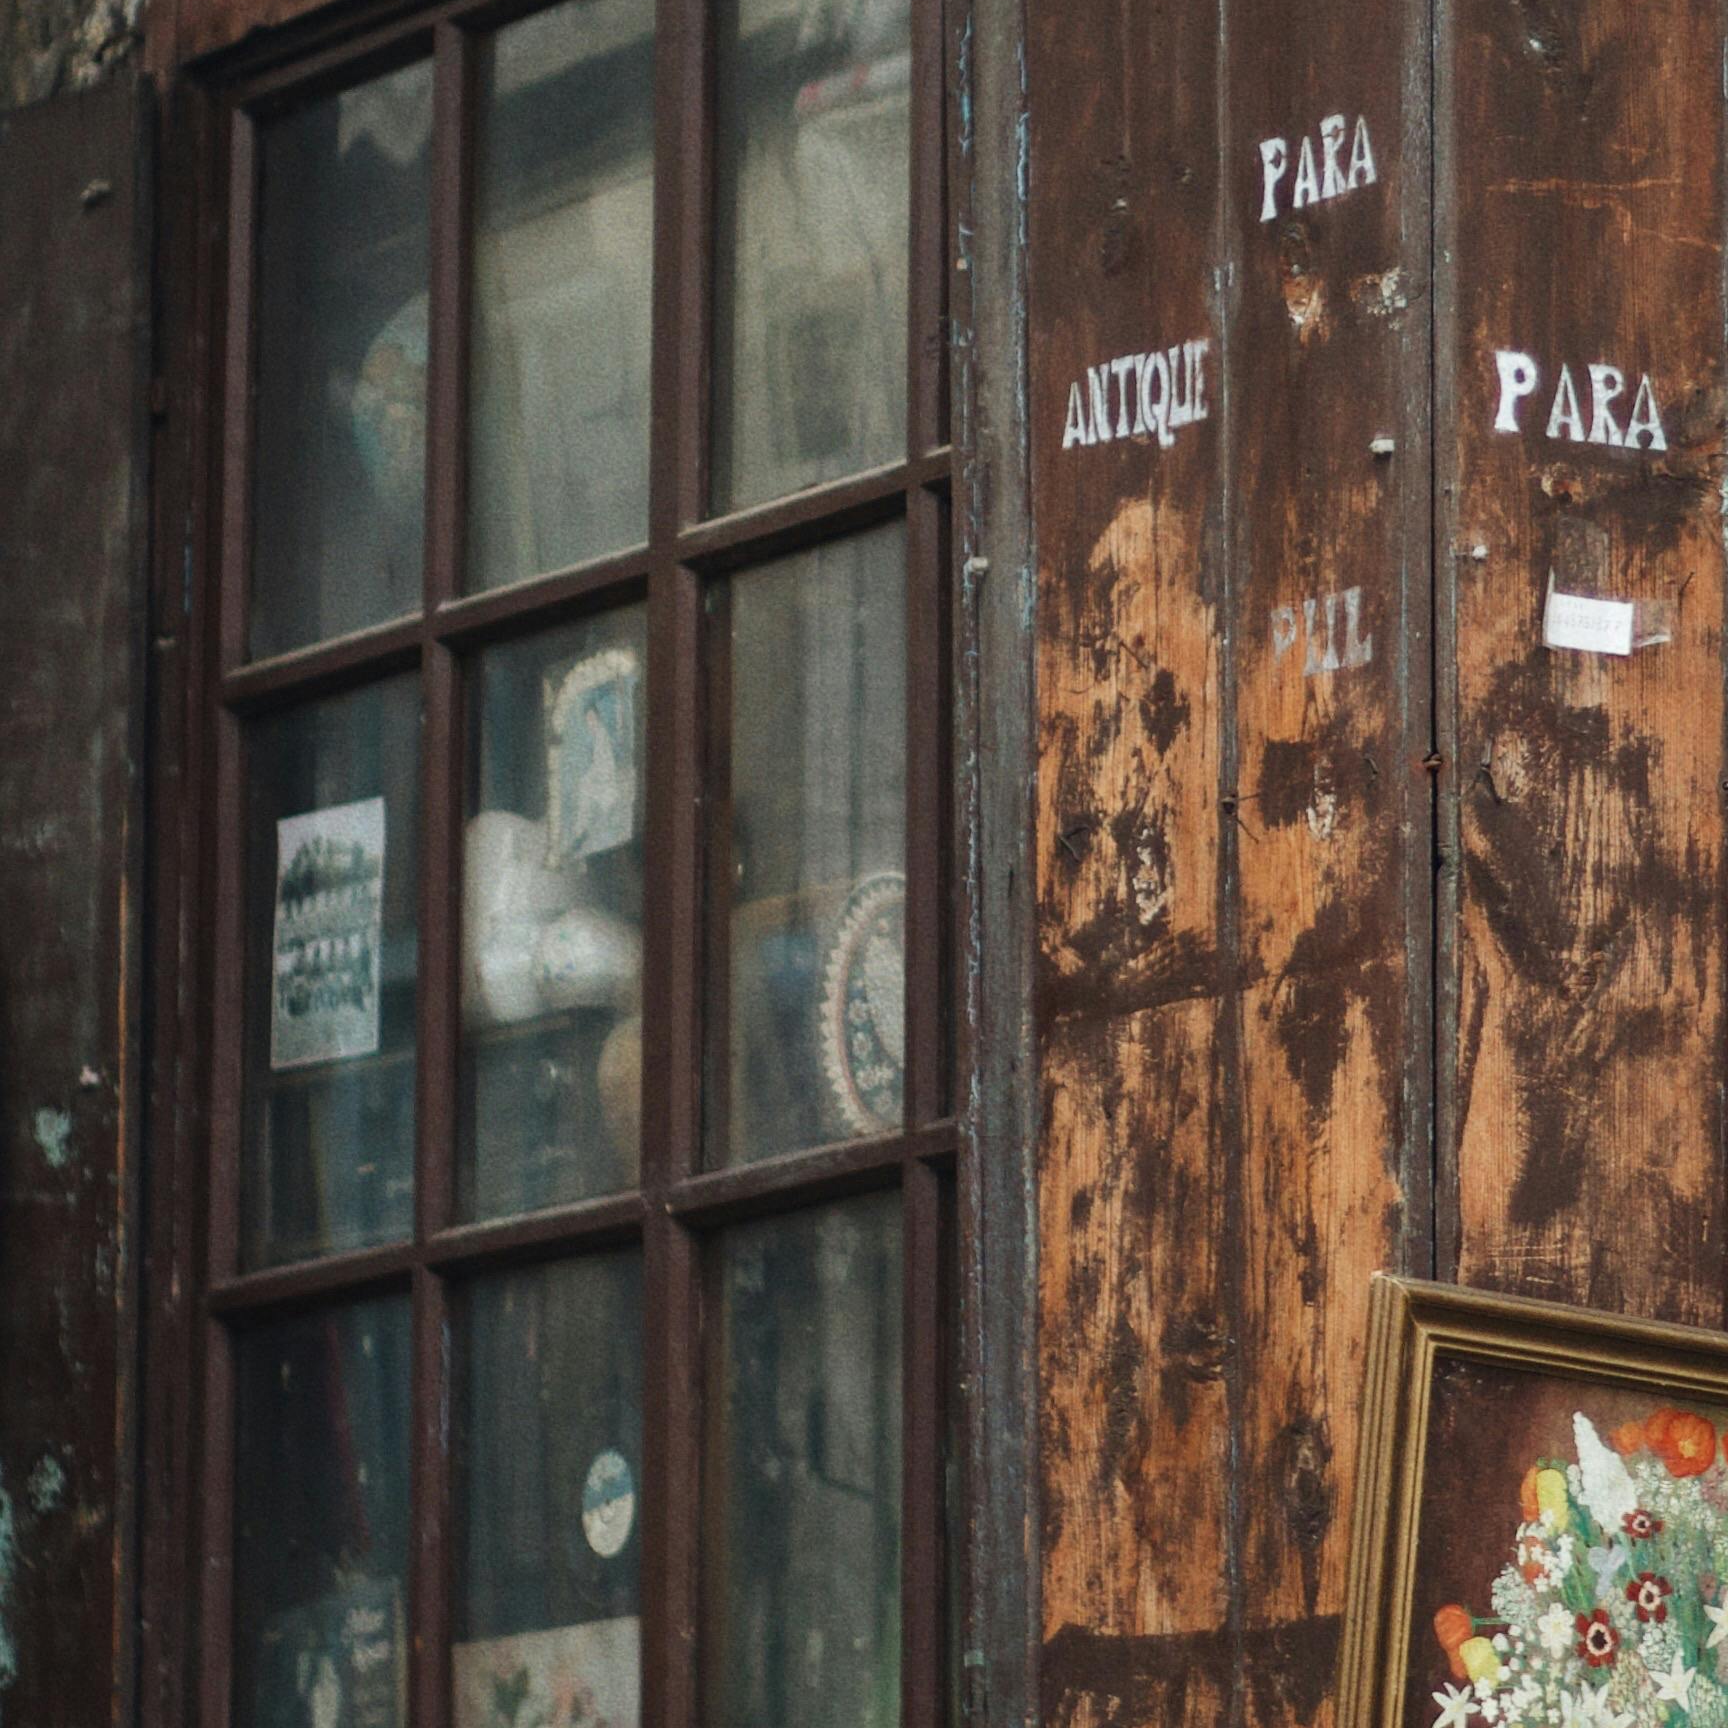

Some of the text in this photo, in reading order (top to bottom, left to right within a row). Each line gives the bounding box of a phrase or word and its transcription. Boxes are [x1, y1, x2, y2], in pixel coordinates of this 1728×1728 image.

[1259, 113, 1377, 223] PARA
[1062, 337, 1212, 450] ANTIQUE
[1493, 348, 1668, 451] PARA
